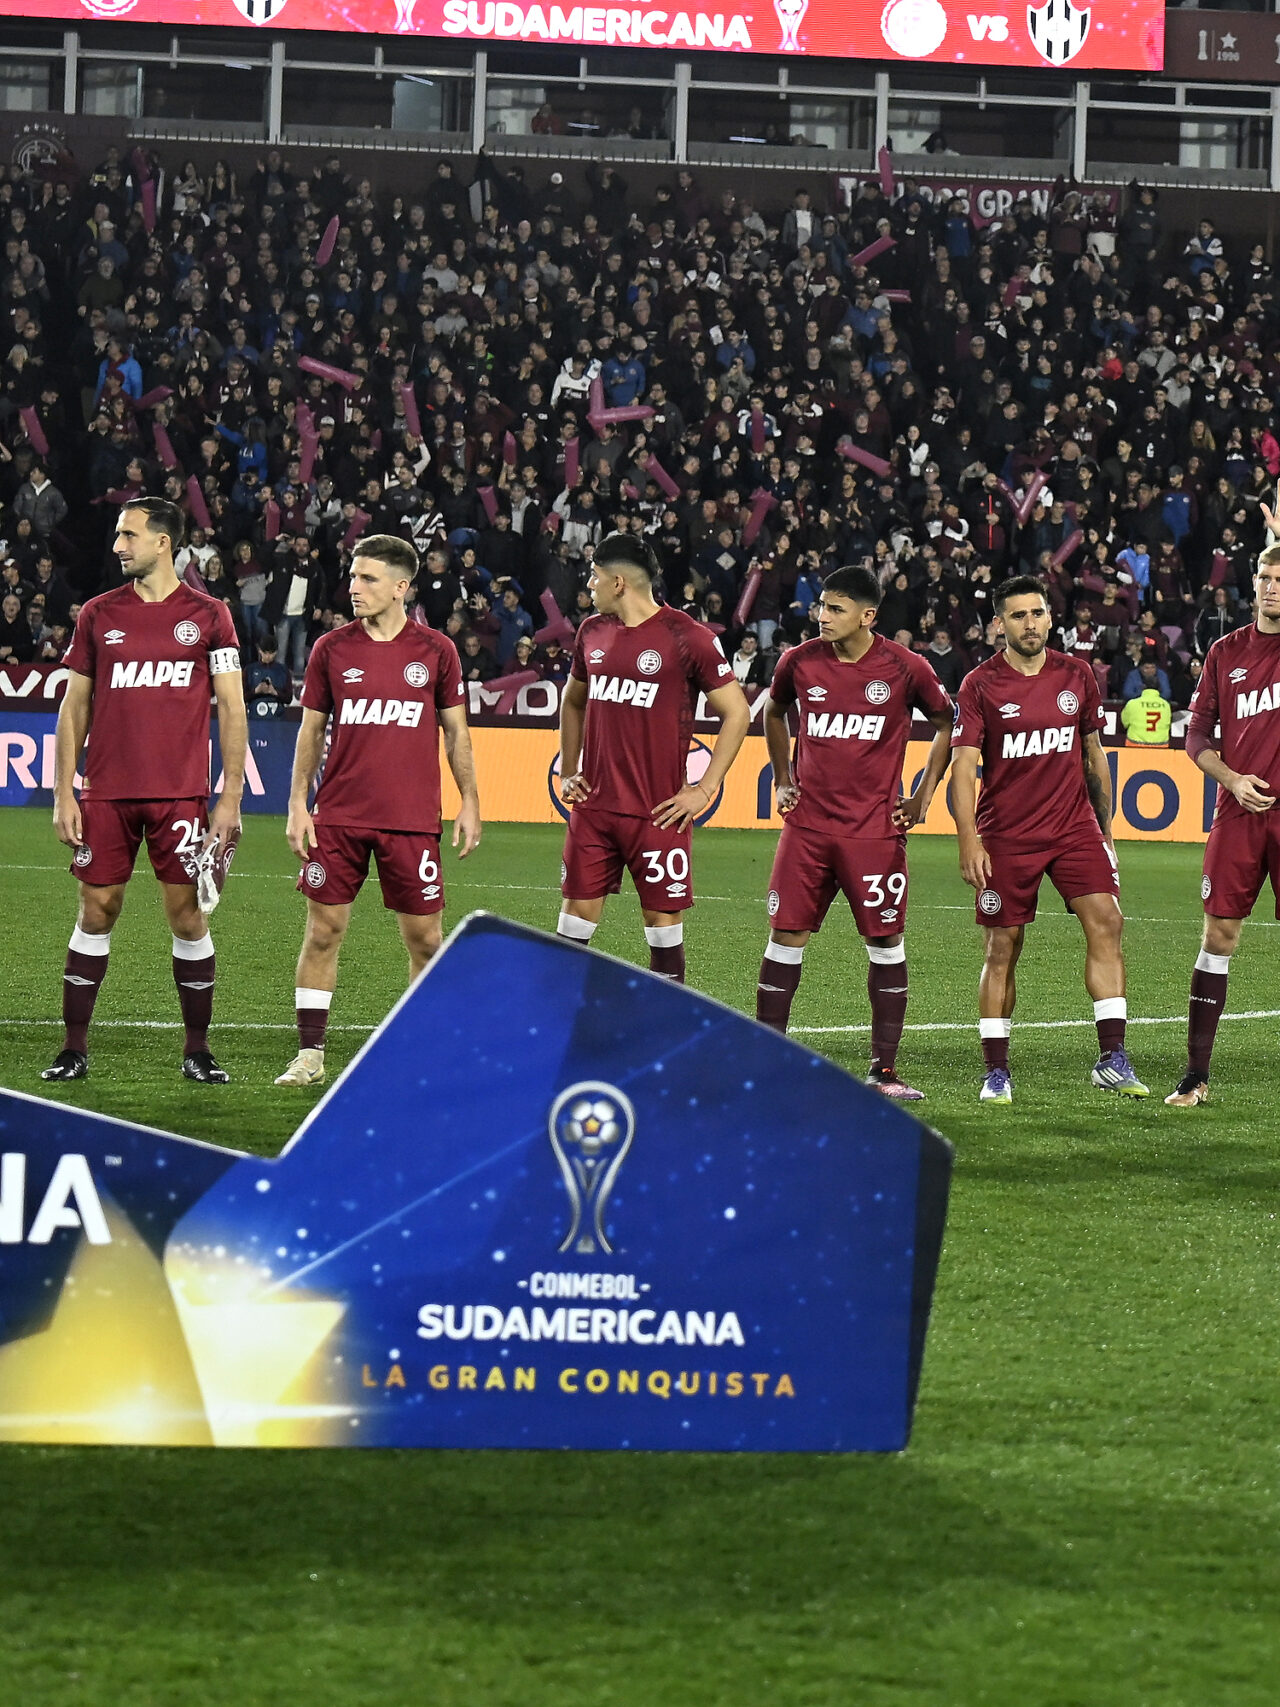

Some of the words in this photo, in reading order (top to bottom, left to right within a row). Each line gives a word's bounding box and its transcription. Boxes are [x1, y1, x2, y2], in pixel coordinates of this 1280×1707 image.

[441, 0, 754, 48] SUDAMERICANA
[966, 14, 1009, 42] VS
[110, 660, 195, 689] MAPEI
[588, 674, 660, 708] MAPEI
[339, 698, 424, 728] MAPEI
[1140, 701, 1166, 709] TECH
[1146, 711, 1162, 732] 3
[806, 712, 886, 741] MAPEI
[1002, 725, 1076, 759] MAPEI
[171, 817, 206, 854] 24
[418, 849, 438, 883] 6
[642, 847, 689, 884] 30
[862, 872, 907, 908] 39
[417, 1303, 745, 1346] SUDAMERICANA
[361, 1364, 406, 1387] LA
[428, 1365, 536, 1391] GRAN
[558, 1367, 795, 1399] CONQUISTA
